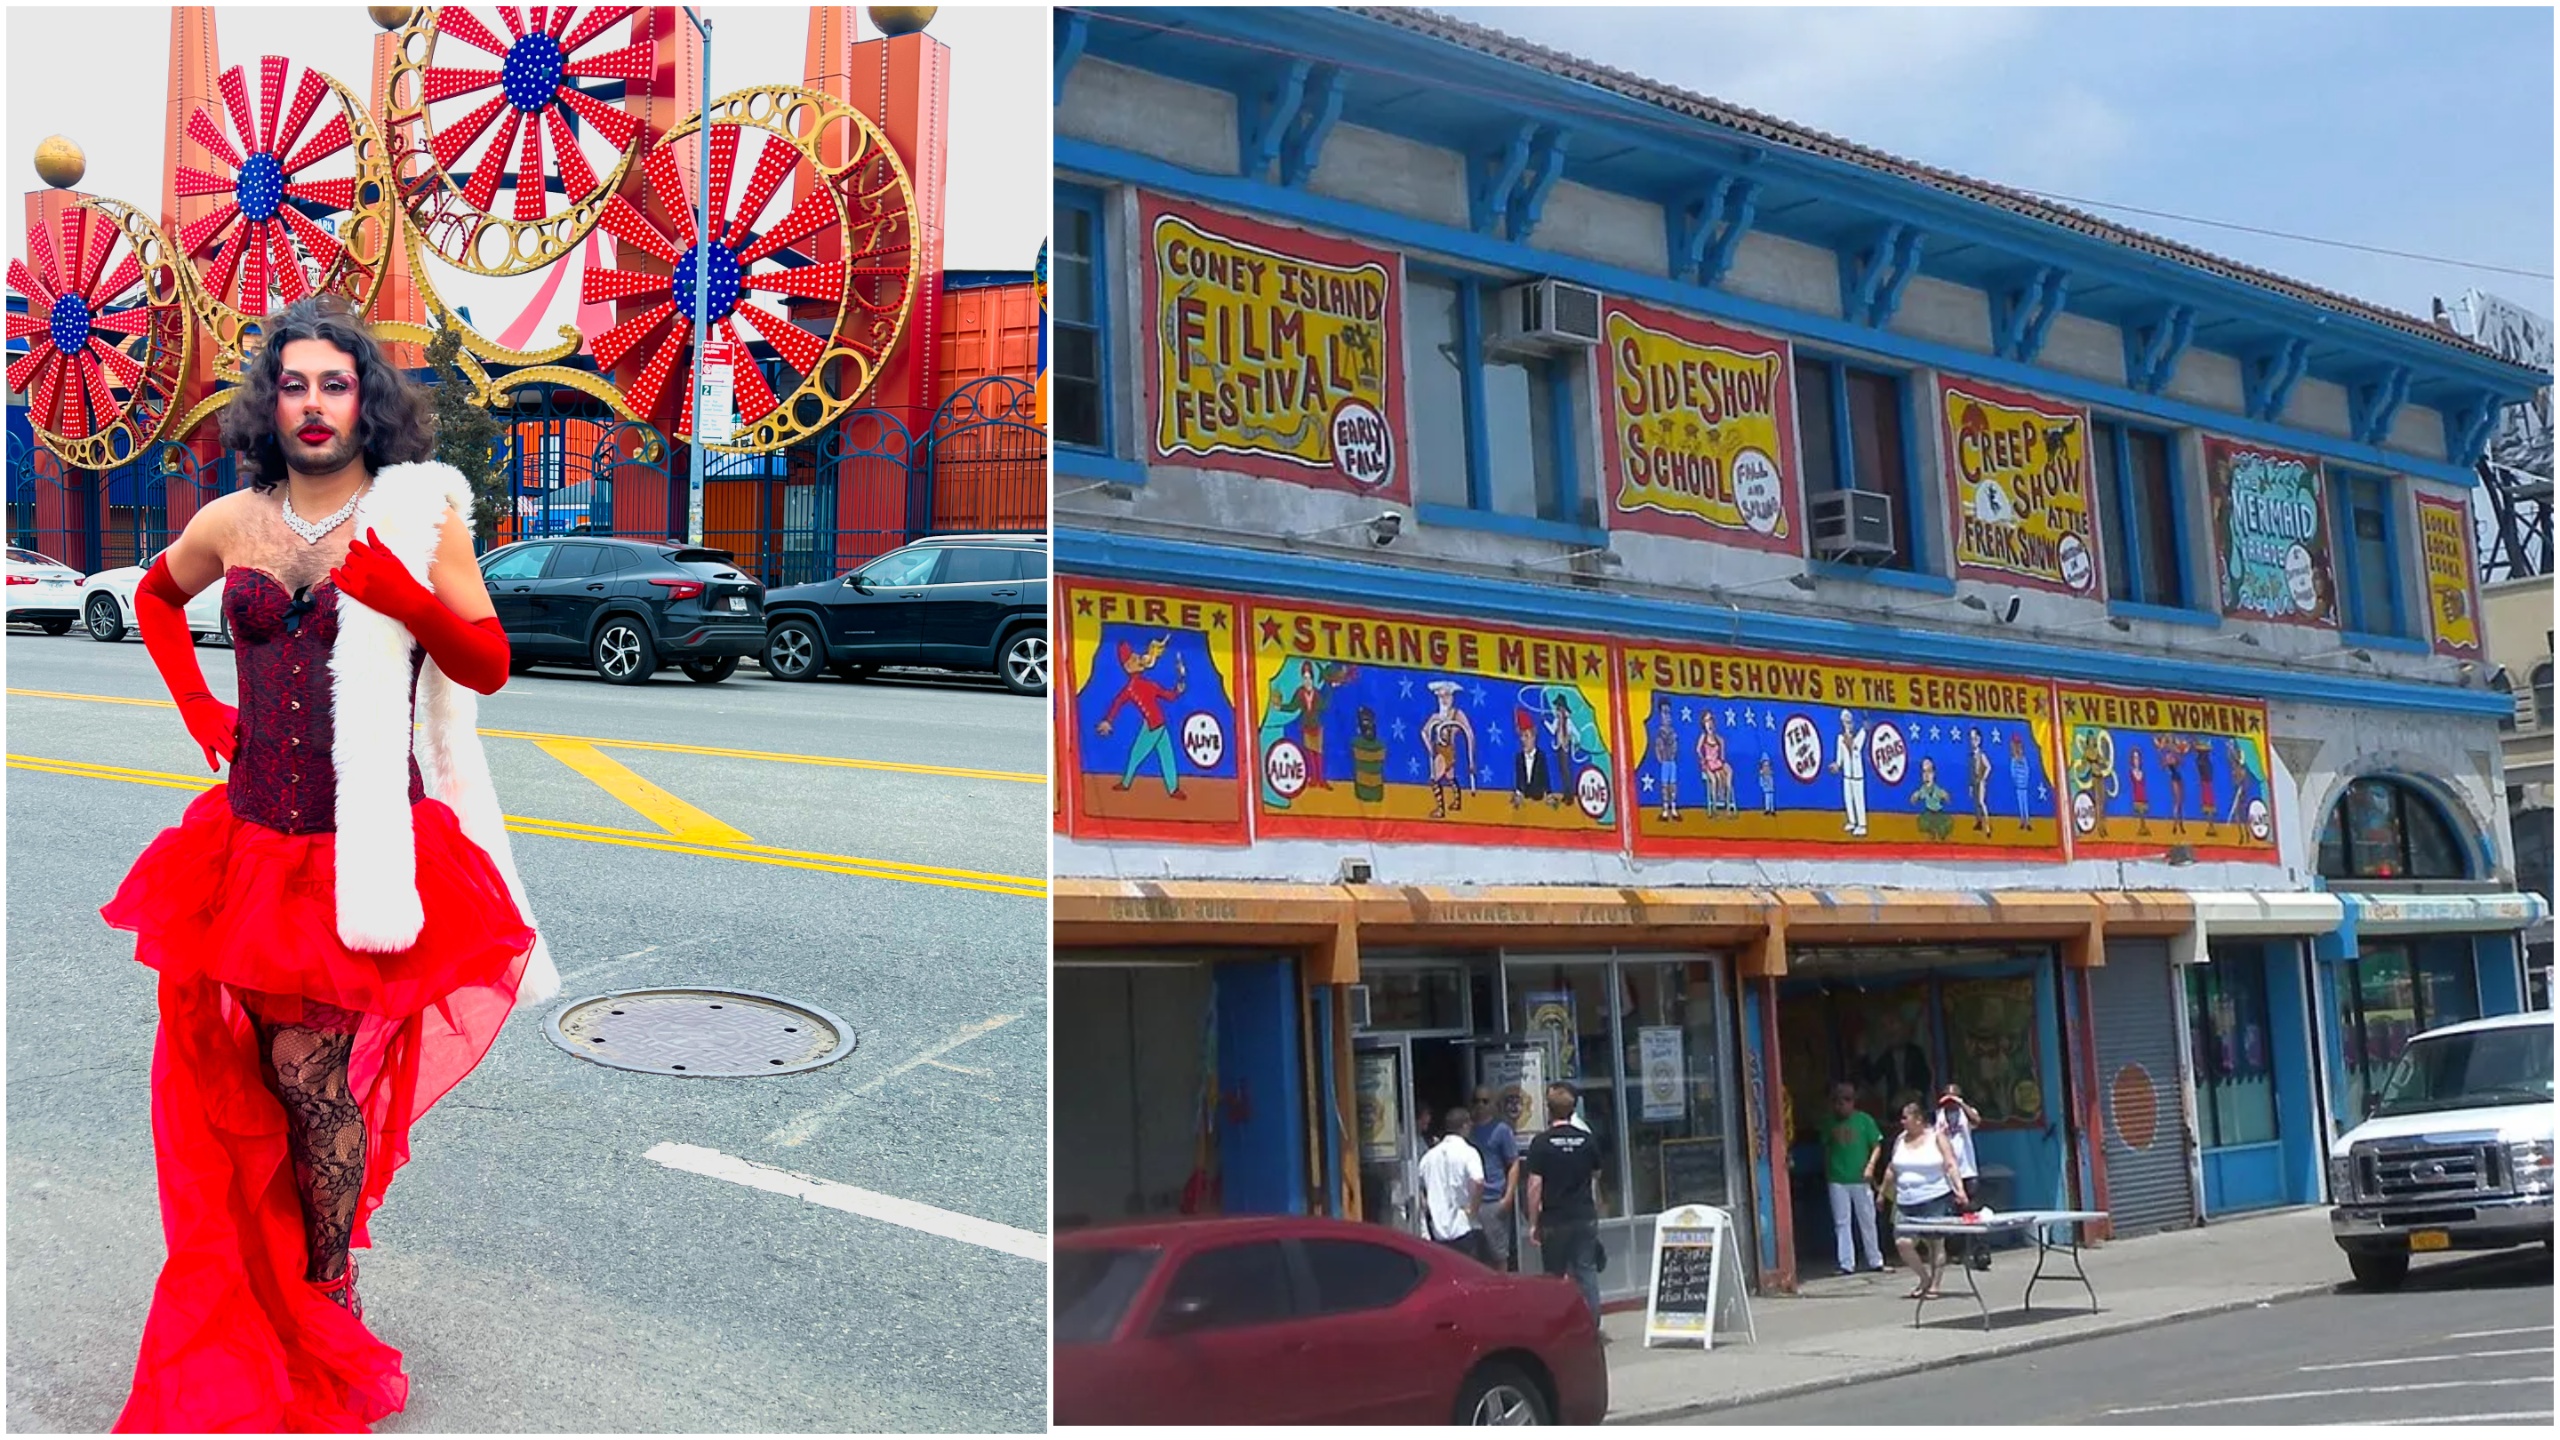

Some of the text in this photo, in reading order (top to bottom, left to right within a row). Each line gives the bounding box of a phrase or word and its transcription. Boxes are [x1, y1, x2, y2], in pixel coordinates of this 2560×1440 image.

[1168, 239, 1381, 321] CONEY ISLAND
[1176, 296, 1305, 383] FILM
[1175, 333, 1353, 438] FESTIVAL
[1620, 337, 1775, 424] SIDESHOW
[1337, 416, 1382, 457] EARLY
[1345, 448, 1384, 475] FALL
[1957, 420, 2037, 484] CREEP
[1628, 423, 1734, 504] SCHOOL
[1737, 461, 1768, 484] FALL
[2013, 458, 2081, 519] SHOW
[2048, 505, 2063, 529] AT
[2232, 489, 2313, 541] MERMAID
[1964, 516, 2019, 566] FREAK
[1100, 596, 1201, 628] FIRE
[1293, 615, 1578, 680] STRANGE MEN
[1654, 654, 2028, 715] SIDESHOWS BY THE SEASHORE
[1787, 722, 1810, 746] TEN
[2080, 697, 2246, 733] WEIRD WOMEN
[1186, 732, 1219, 753] ALIVE
[1268, 760, 1304, 781] ALIVE
